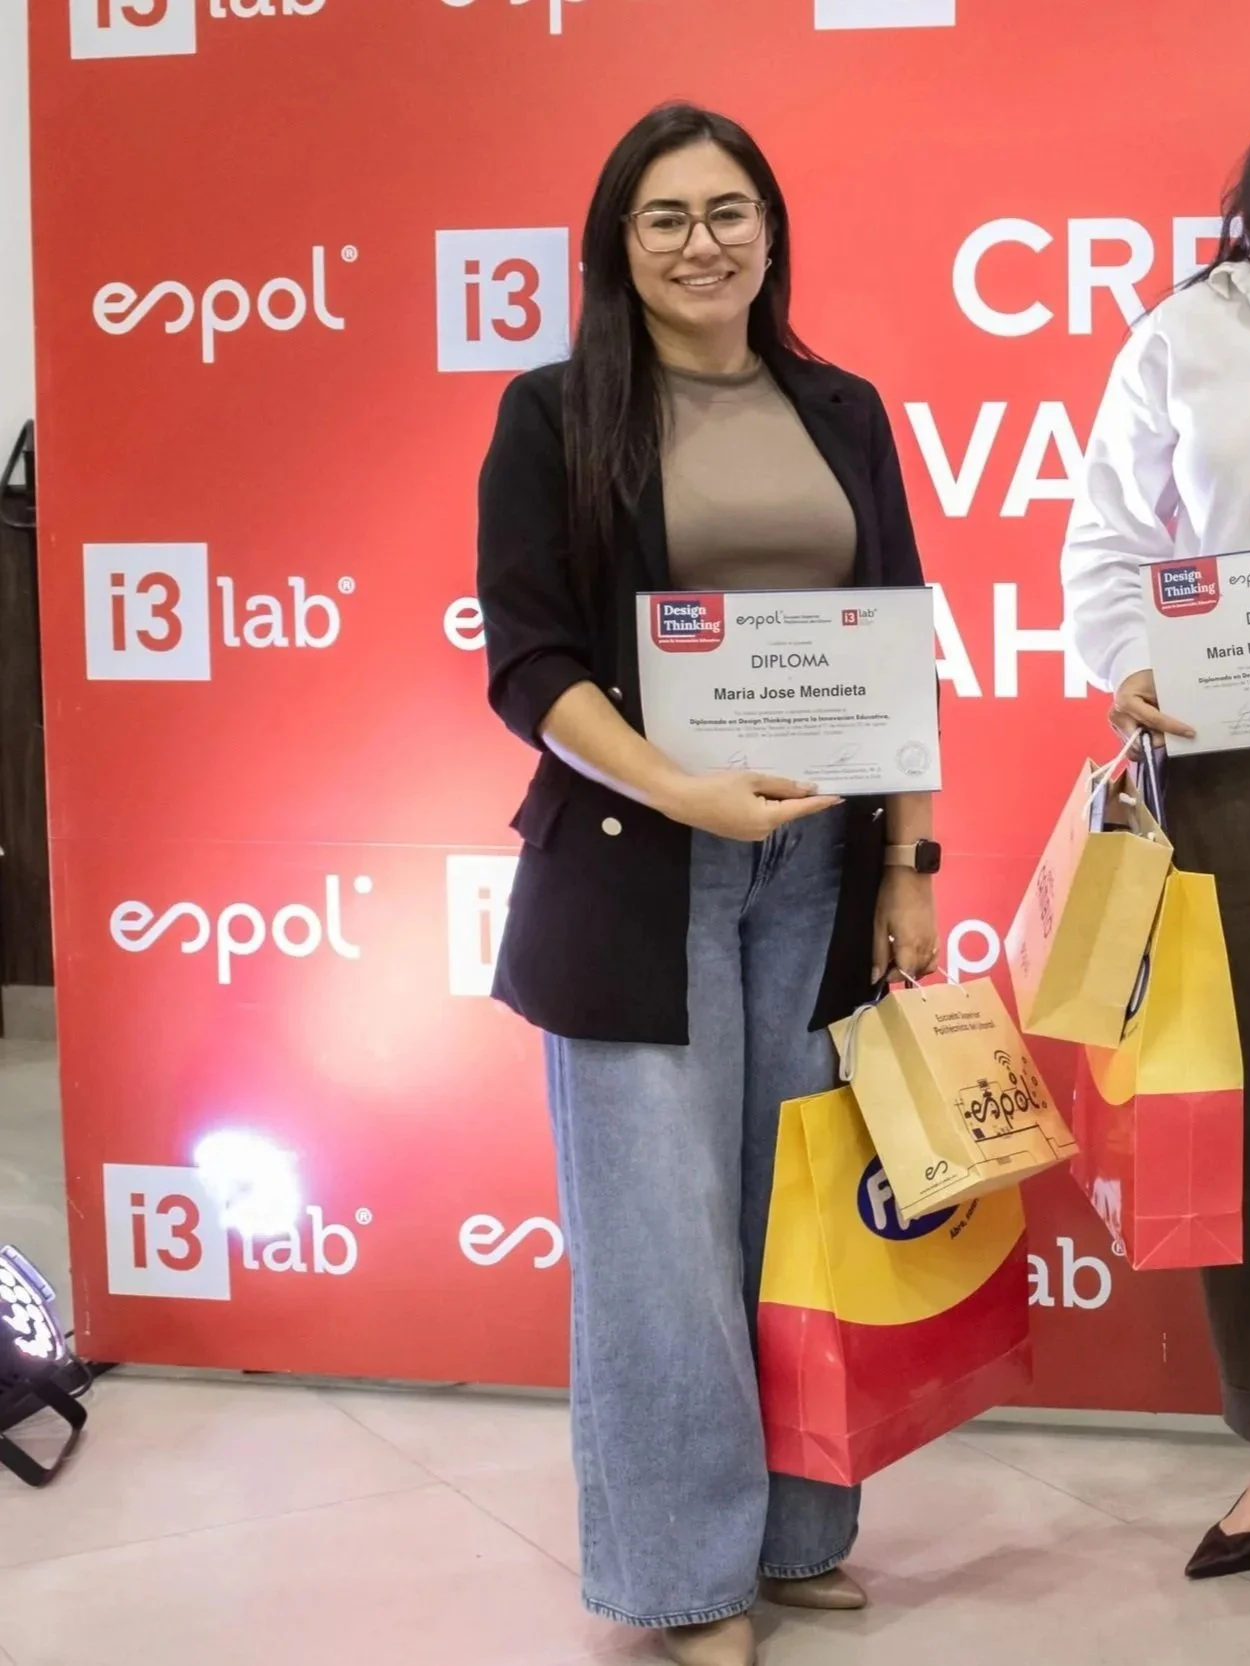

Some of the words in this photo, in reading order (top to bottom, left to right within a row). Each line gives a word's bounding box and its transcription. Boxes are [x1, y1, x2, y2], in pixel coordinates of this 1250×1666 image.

[1164, 570, 1202, 583] Design
[1165, 583, 1216, 598] Thinking
[664, 605, 706, 617] Design
[664, 620, 721, 633] Thinking
[1206, 645, 1244, 660] Maria
[751, 654, 830, 668] DIPLOMA
[714, 688, 755, 700] Maria
[760, 687, 796, 700] Jose
[800, 684, 867, 698] Mendieta
